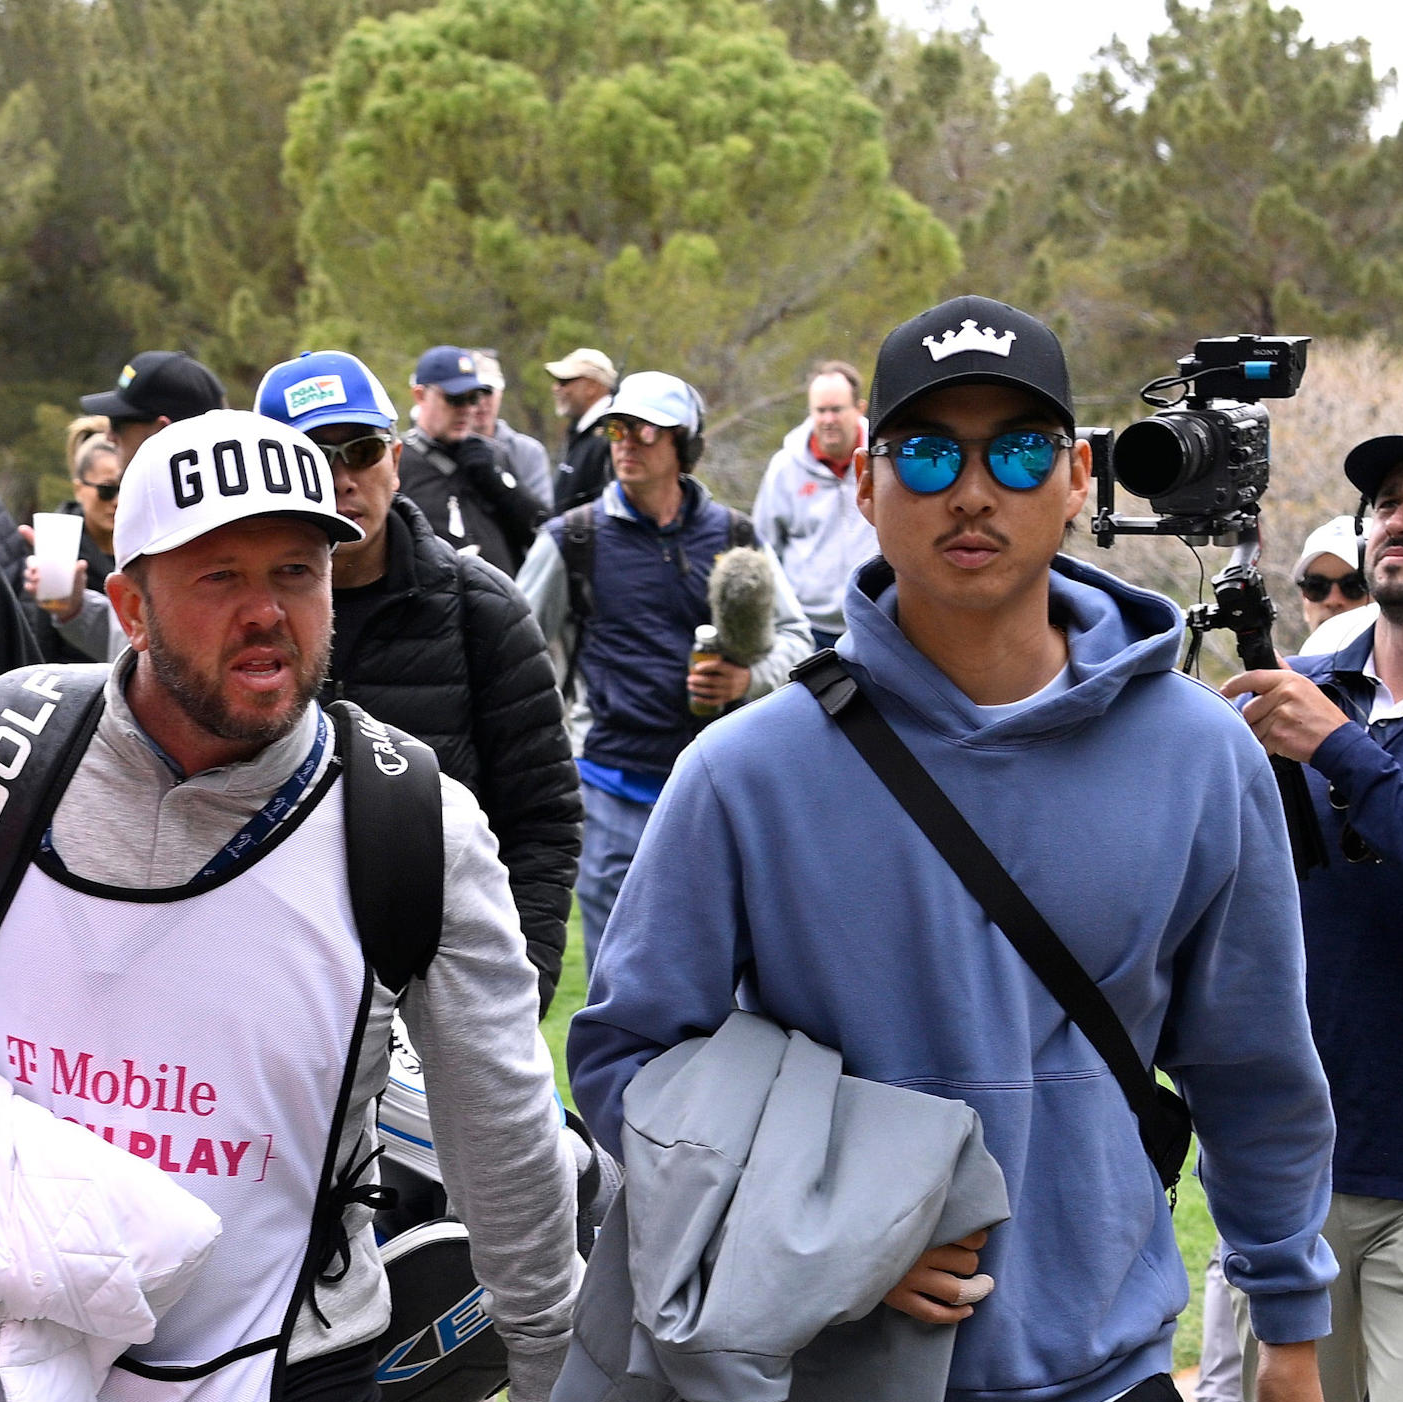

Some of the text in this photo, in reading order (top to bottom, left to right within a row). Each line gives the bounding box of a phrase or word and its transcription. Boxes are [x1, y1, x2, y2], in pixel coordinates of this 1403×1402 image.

[170, 438, 323, 509] GOOD
[49, 1046, 217, 1117] Mobile
[129, 1130, 252, 1177] PLAY
